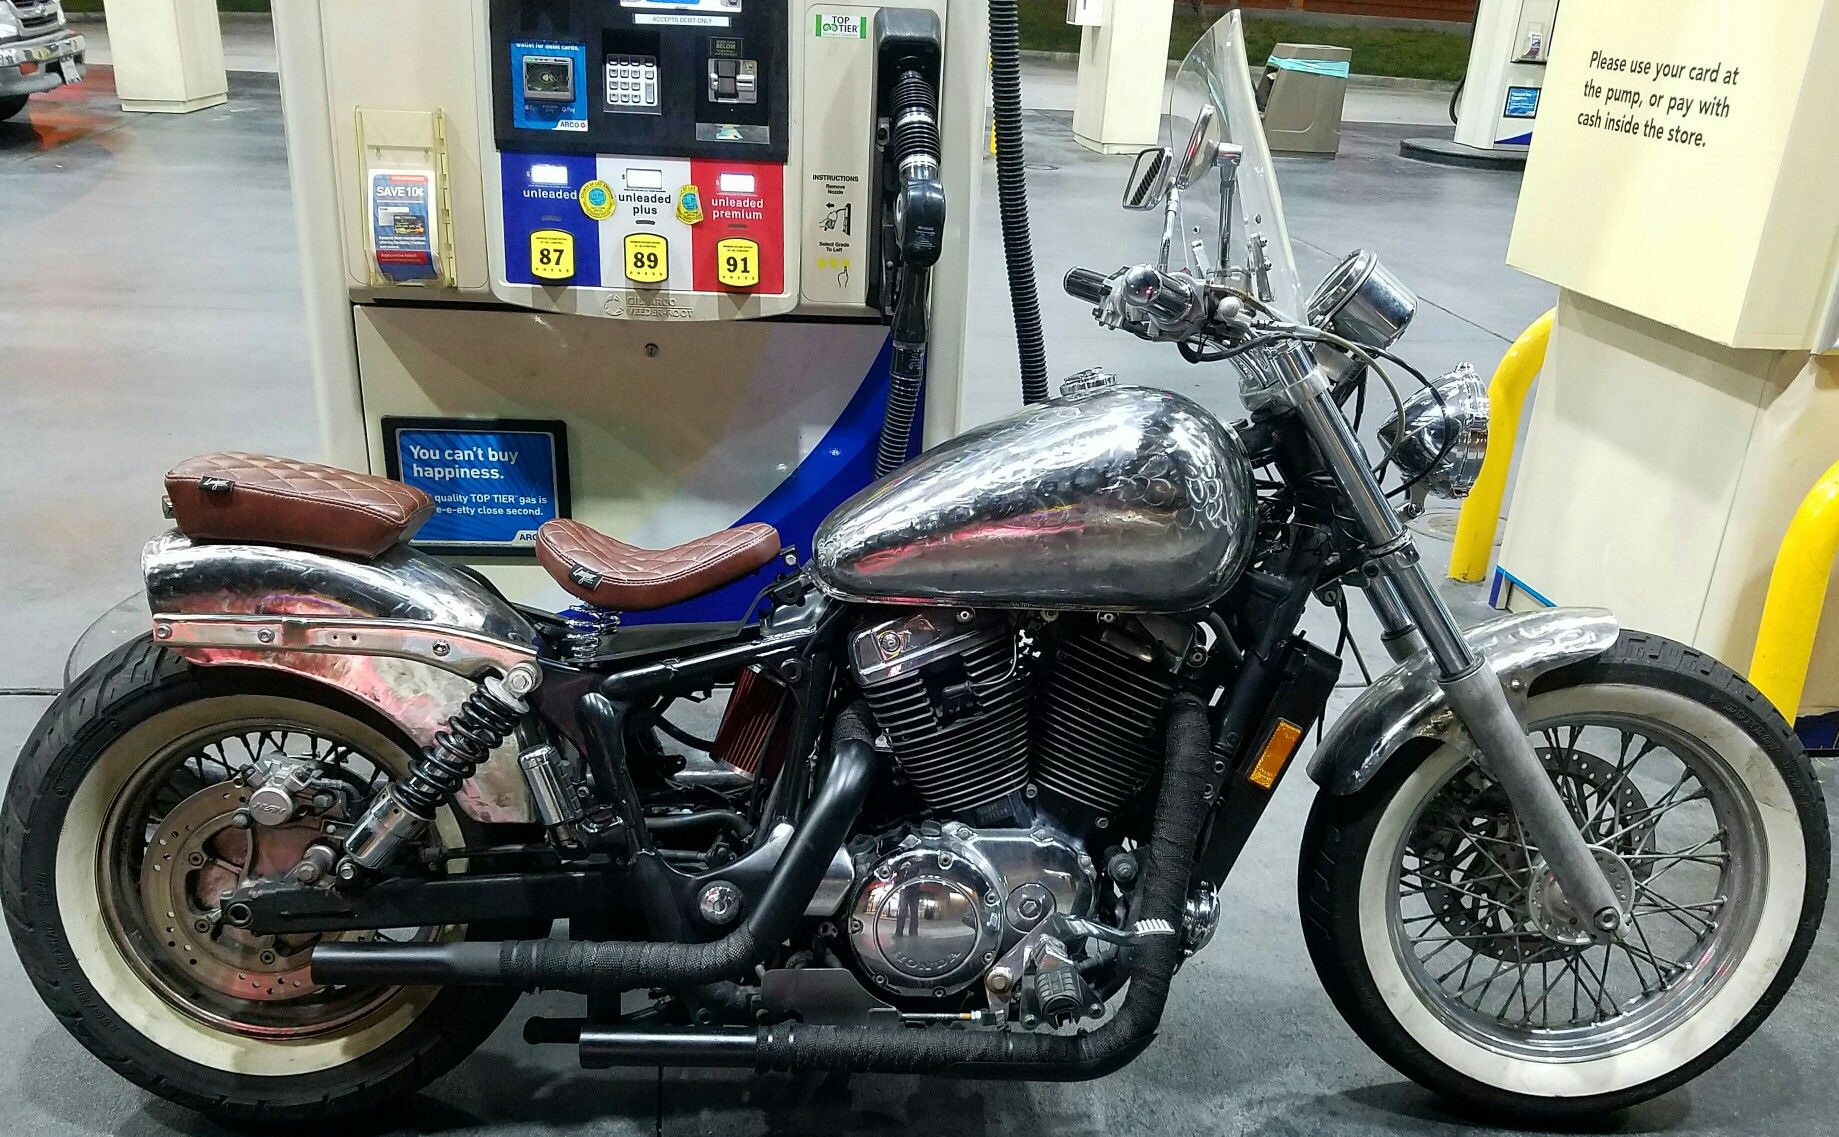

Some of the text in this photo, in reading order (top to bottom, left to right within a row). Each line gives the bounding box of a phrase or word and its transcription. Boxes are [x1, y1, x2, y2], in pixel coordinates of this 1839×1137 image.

[832, 16, 850, 24] TOP
[839, 25, 857, 33] TIER
[1589, 50, 1740, 85] Please use your card at
[1583, 78, 1730, 118] the pump, or pay with
[560, 121, 579, 129] ARCO
[1577, 109, 1706, 147] cash inside the store.
[812, 174, 859, 182] INSTRUCTIONS
[376, 186, 405, 197] SAVE
[523, 188, 577, 200] unleaded
[618, 192, 671, 204] unleaded
[711, 196, 764, 208] unleaded
[633, 204, 657, 216] plus
[712, 208, 763, 220] premium
[539, 247, 565, 266] 87
[633, 251, 659, 269] 89
[726, 256, 750, 274] 91
[627, 296, 677, 307] GILARCO
[629, 307, 693, 318] VEEDER-ROOT
[410, 446, 519, 464] You can't buy
[413, 464, 505, 480] happiness.
[434, 493, 468, 504] quality
[470, 494, 491, 503] TOP
[519, 496, 537, 505] gas
[538, 496, 548, 504] is
[477, 506, 504, 515] close
[506, 507, 544, 516] second.
[519, 533, 538, 541] ARC
